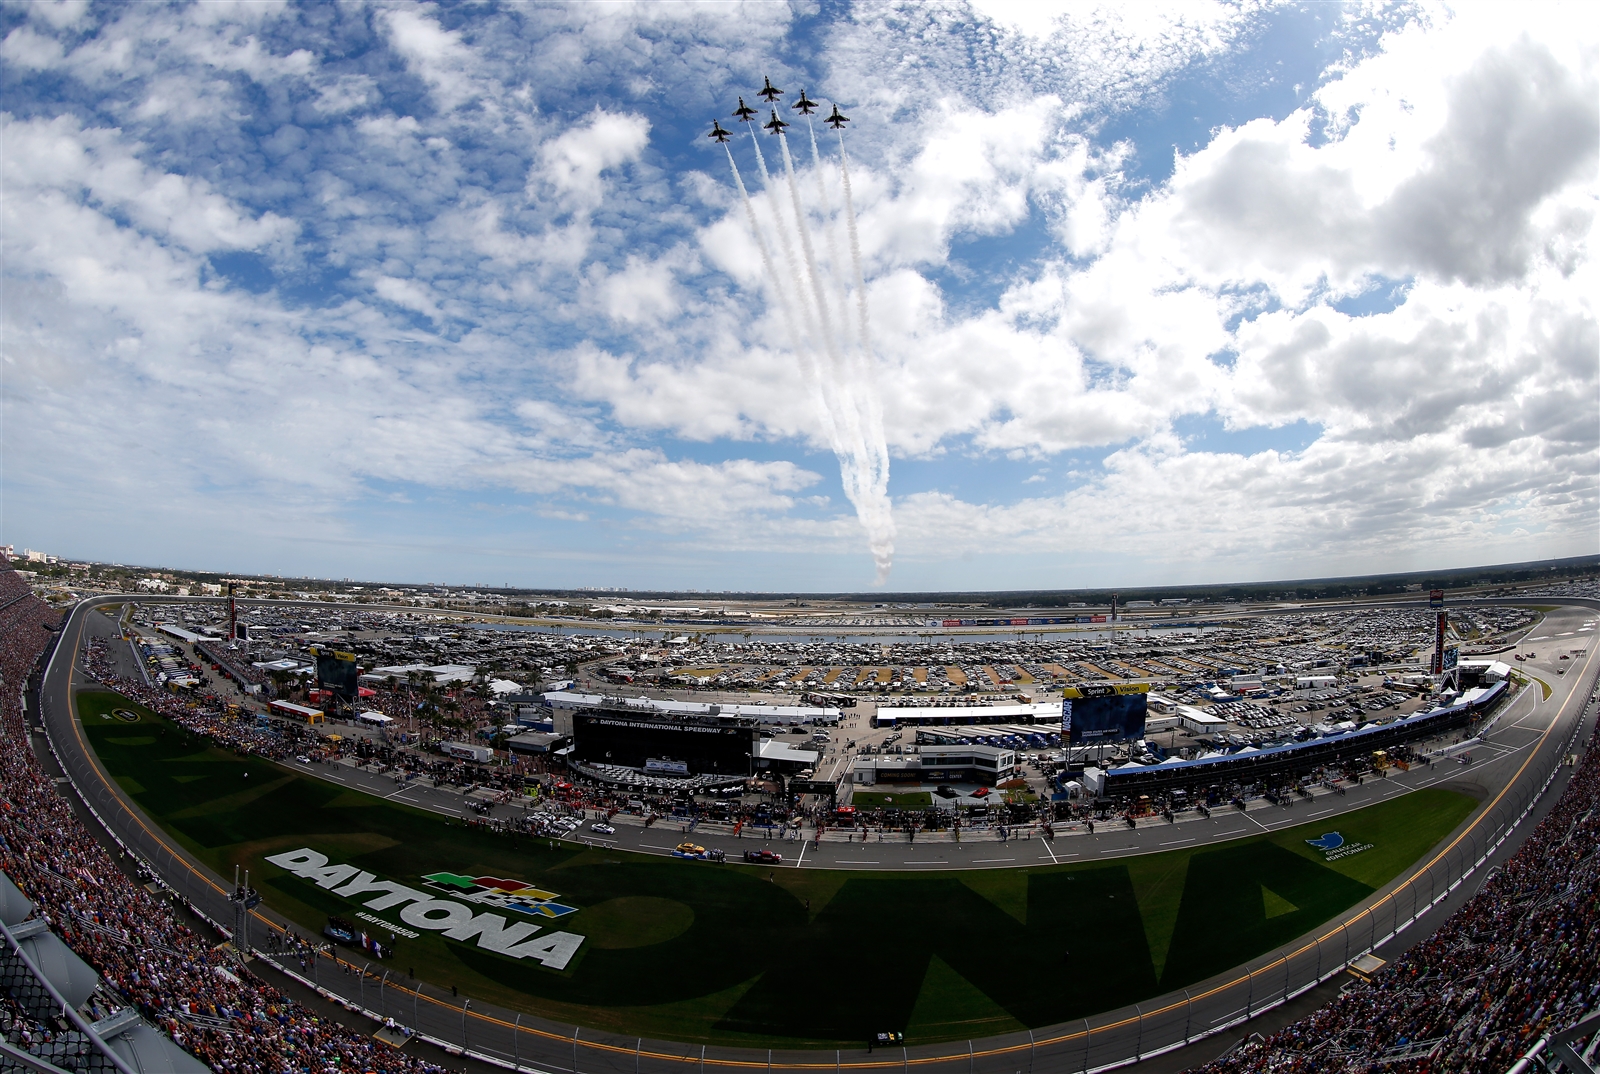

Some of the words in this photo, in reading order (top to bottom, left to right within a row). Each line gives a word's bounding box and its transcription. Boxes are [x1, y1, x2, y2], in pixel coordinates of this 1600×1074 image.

[600, 719, 628, 727] DAYTONA
[629, 722, 682, 732] INTERNATIONAL
[684, 726, 722, 734] SPEEDWAY
[1063, 701, 1072, 731] NASCAR
[264, 847, 586, 970] DAYTONA
[355, 911, 420, 939] #DAYTONA500
